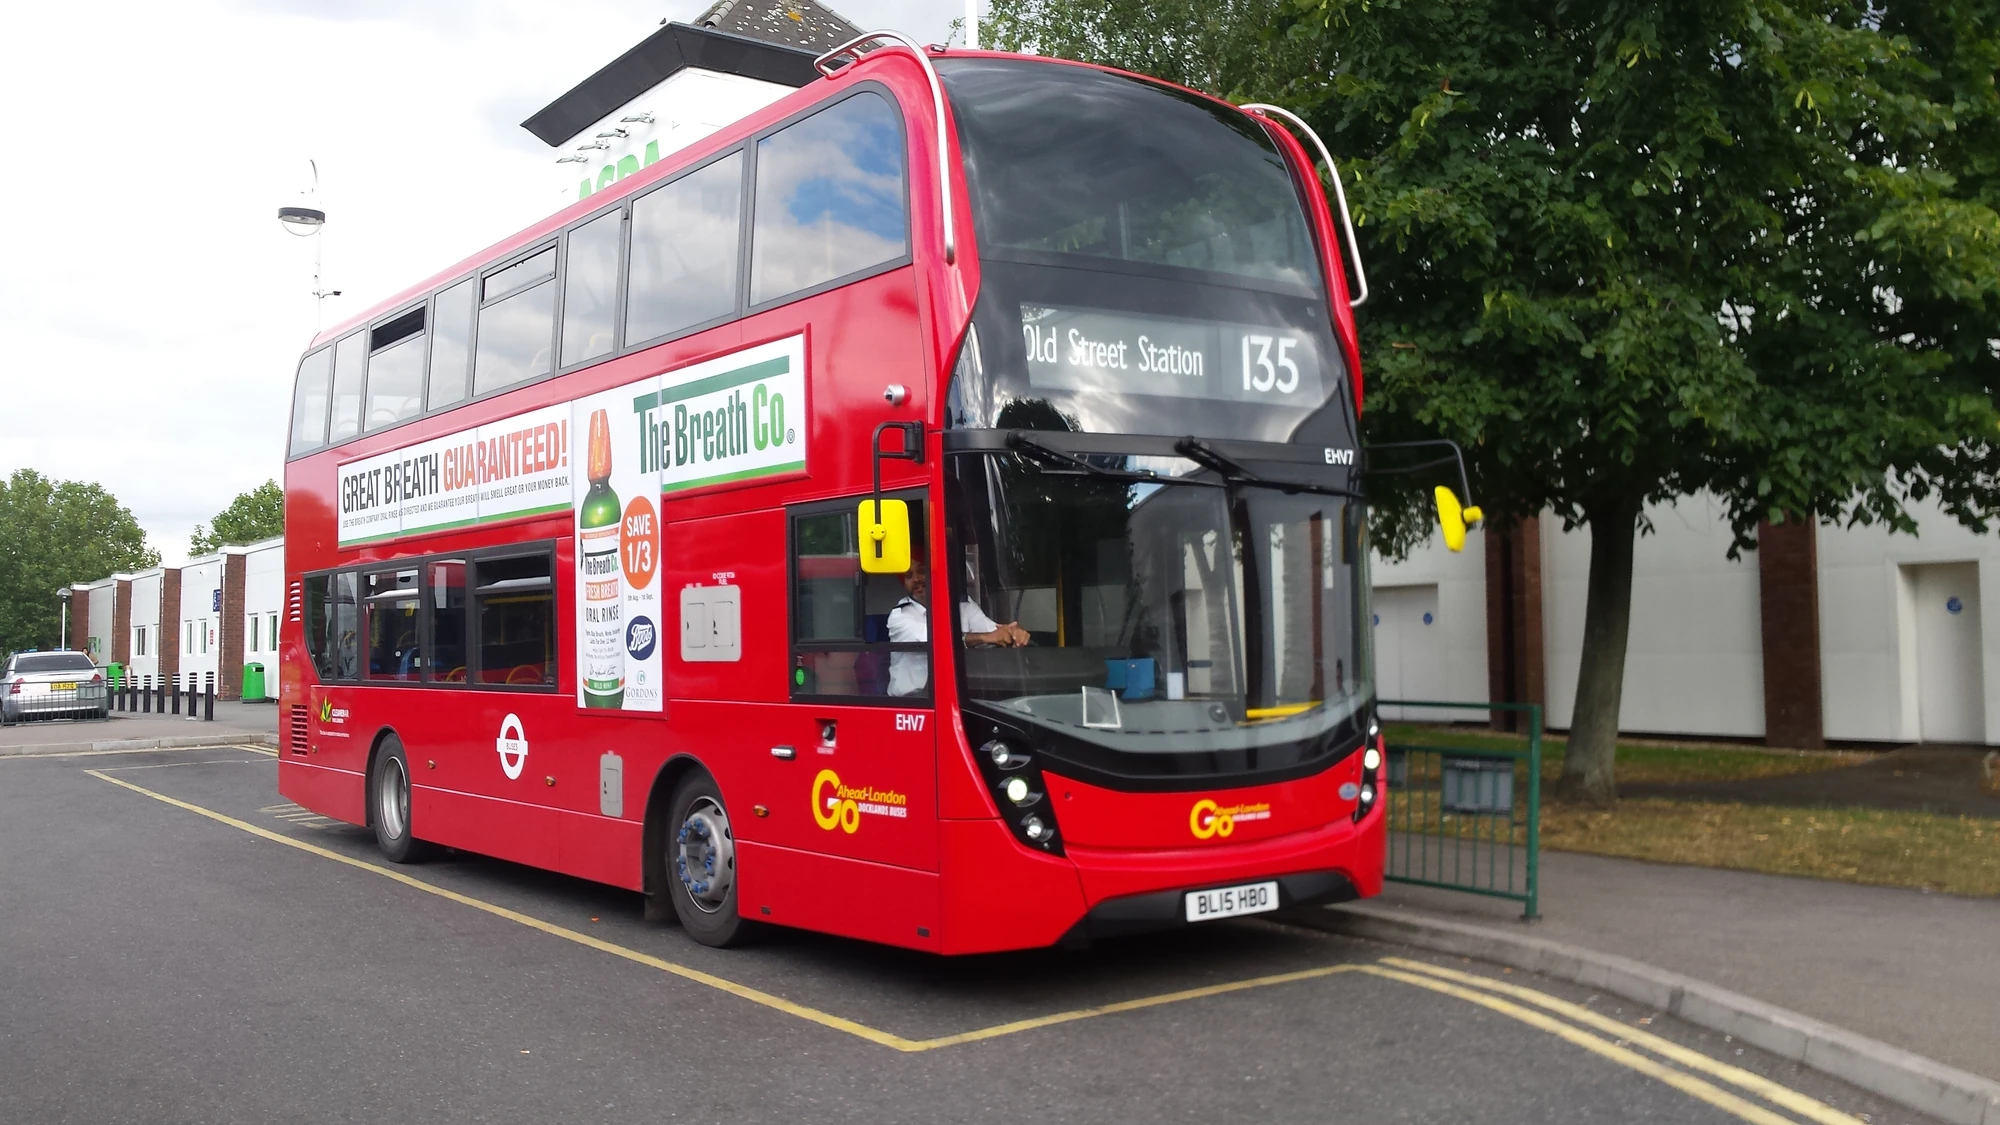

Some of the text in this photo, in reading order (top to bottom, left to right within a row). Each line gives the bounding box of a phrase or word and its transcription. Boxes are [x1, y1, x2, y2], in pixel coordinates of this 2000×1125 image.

[1023, 324, 1203, 376] Old Street Station
[1242, 335, 1299, 394] 135
[633, 388, 670, 474] The
[675, 389, 748, 467] Breath
[342, 419, 568, 514] GREAT BREATH GUARANTEED!
[1325, 448, 1354, 465] EHV7
[403, 505, 420, 516] DIRECTED
[420, 503, 428, 512] AND
[434, 498, 455, 510] GUARANTEE
[465, 493, 480, 504] BREATH
[480, 491, 490, 501] WILL
[490, 489, 504, 499] SMELL
[504, 485, 518, 497] GREAT
[518, 483, 525, 494] OR
[525, 481, 537, 493] YOUR
[537, 478, 554, 490] MONEY
[555, 476, 570, 488] BACK.
[626, 513, 651, 538] SAVE
[593, 555, 611, 575] Breath
[627, 540, 652, 574] 1/3
[586, 583, 600, 600] FRESH
[586, 604, 619, 623] ORAL RINSE
[629, 623, 653, 652] Boots
[625, 686, 658, 699] GORDONS
[896, 714, 925, 731] EHV7
[812, 769, 860, 834] Go
[837, 785, 906, 805] Ahead-London
[858, 802, 907, 818] DOCKLANDS BUSES
[1190, 799, 1234, 838] Go
[1198, 887, 1268, 915] BL15 HBO
